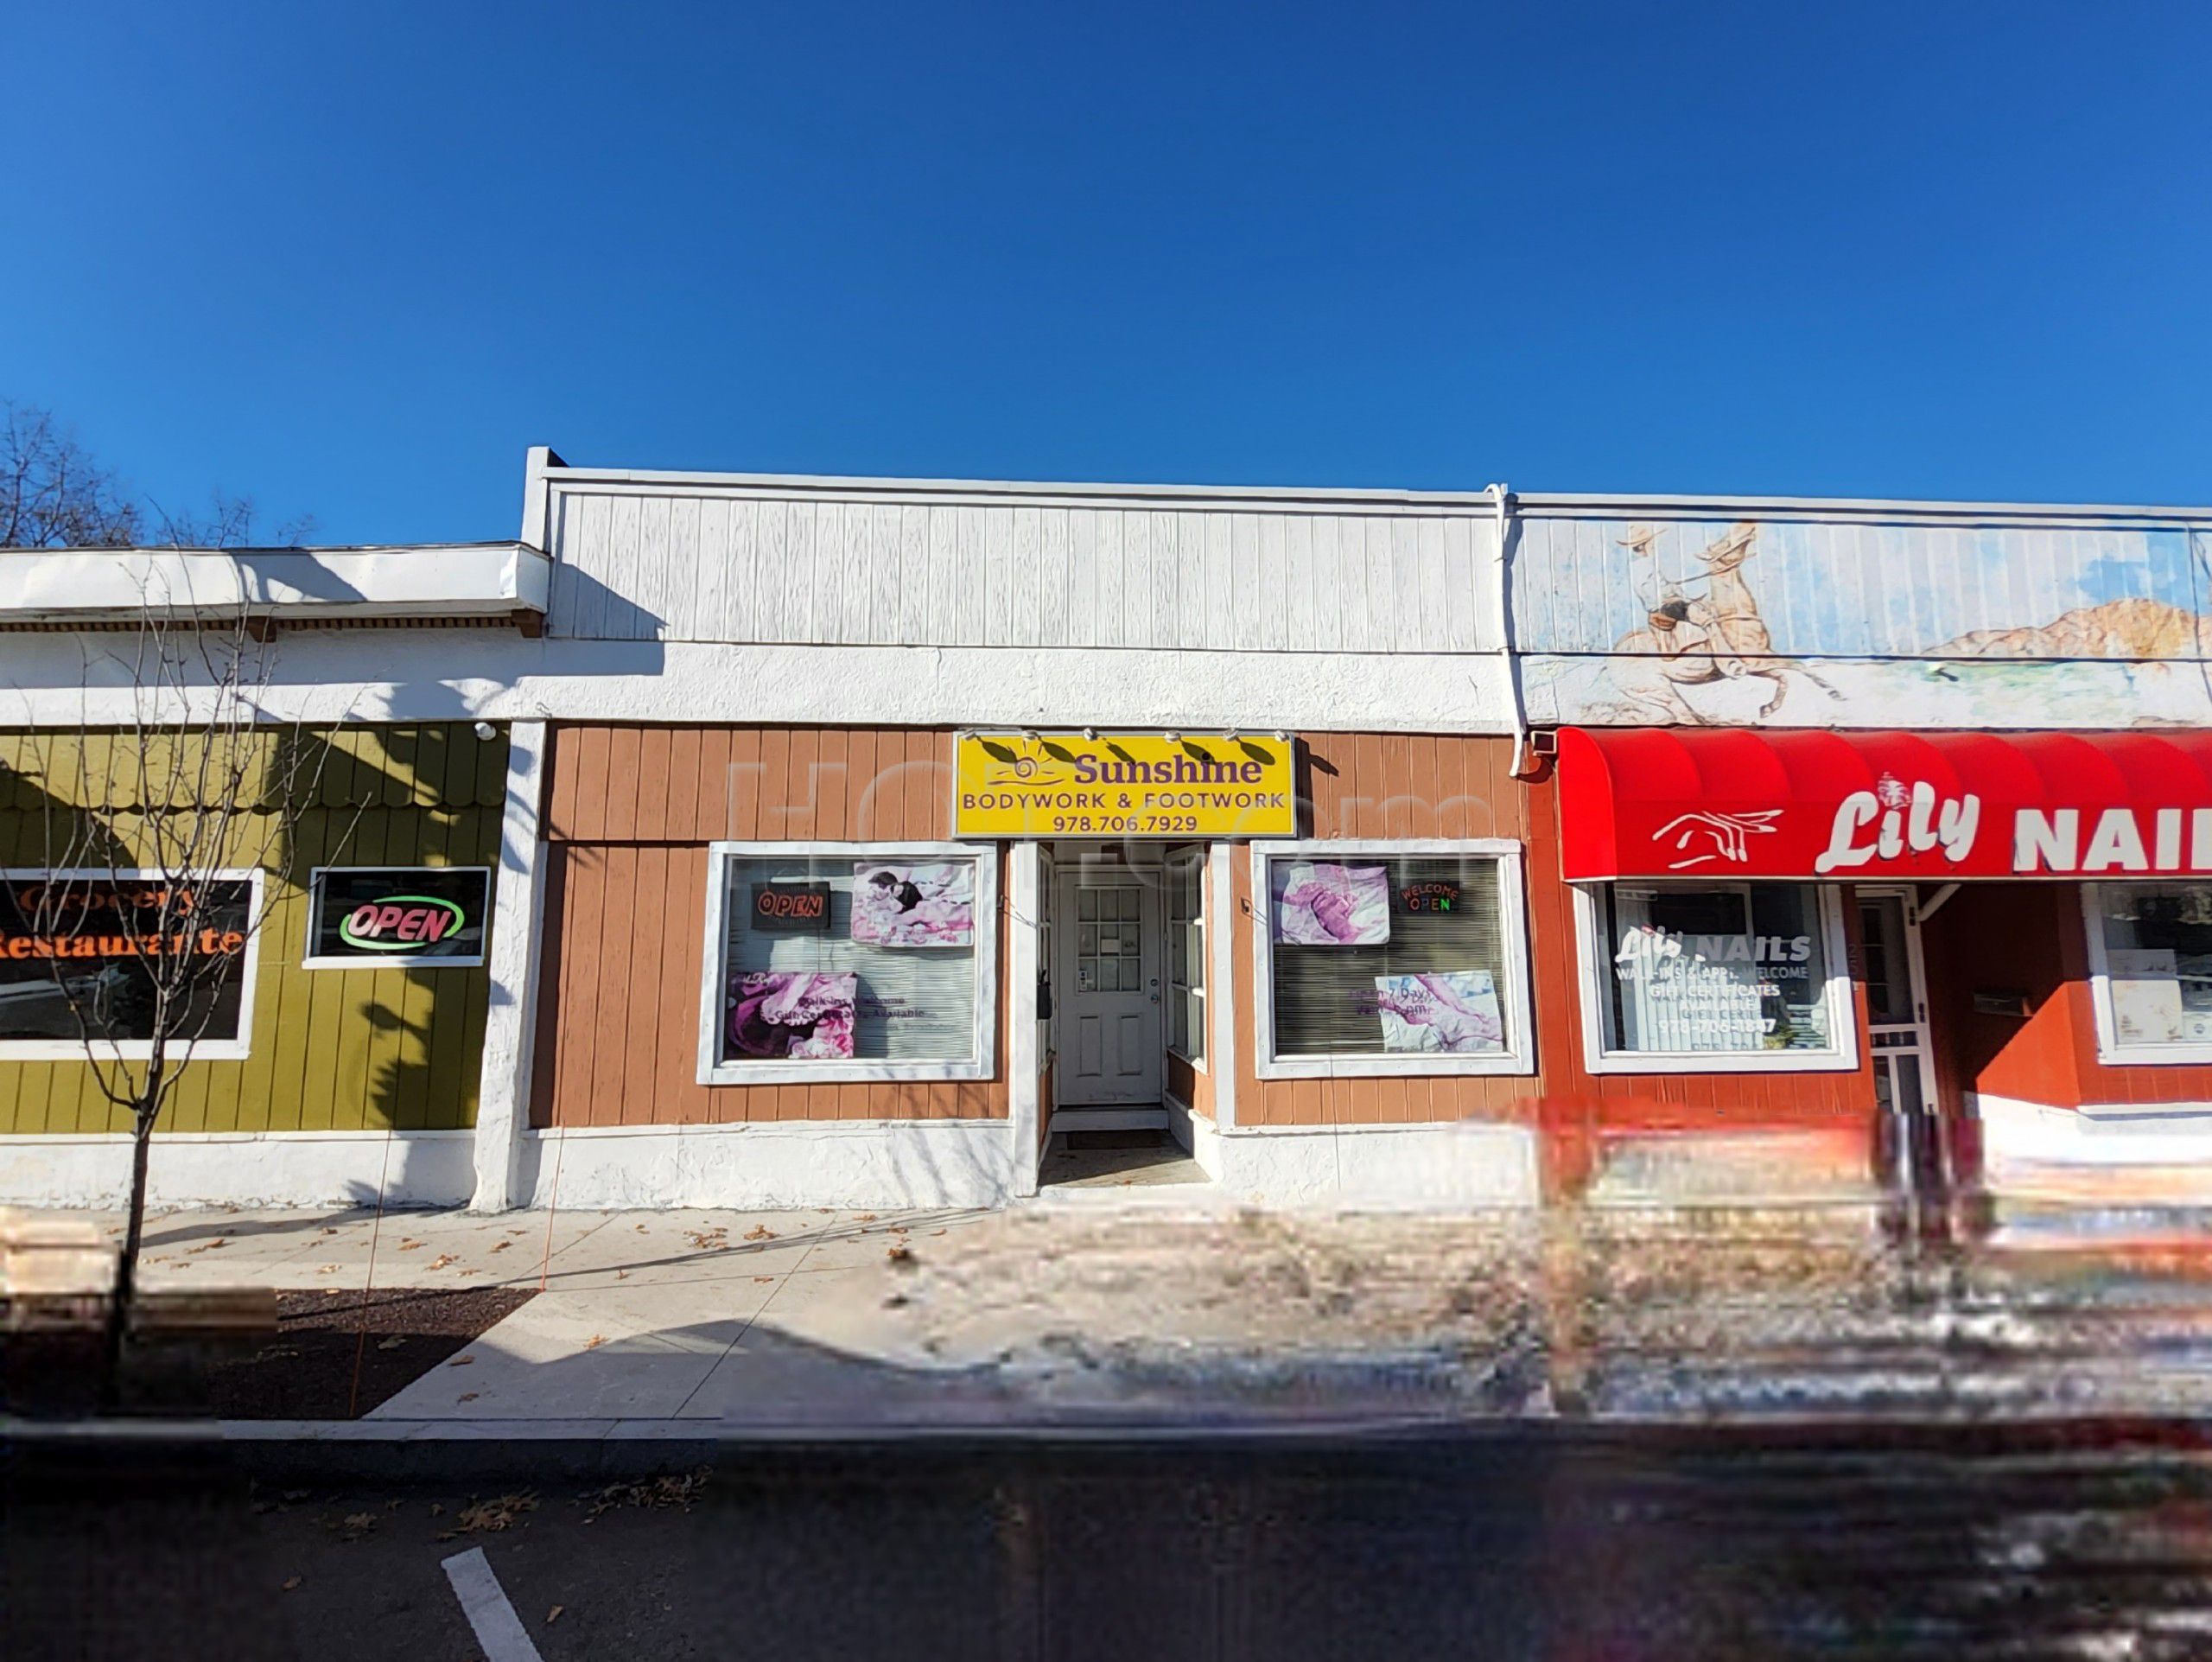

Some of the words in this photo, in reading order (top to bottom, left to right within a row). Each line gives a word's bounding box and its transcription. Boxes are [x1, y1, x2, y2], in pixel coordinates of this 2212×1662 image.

[1073, 754, 1262, 785] Sunshine
[963, 793, 1106, 810] BODYWORK
[1118, 793, 1133, 809] &
[1144, 792, 1285, 809] FOOTWORK
[1052, 816, 1198, 832] 978.706.7929
[1815, 780, 1980, 873] Lily
[758, 890, 823, 917] OPEN
[1401, 883, 1459, 901] WELCOME
[1408, 898, 1451, 912] OPEN
[347, 905, 452, 943] OPEN
[1694, 936, 1812, 963] NAILS
